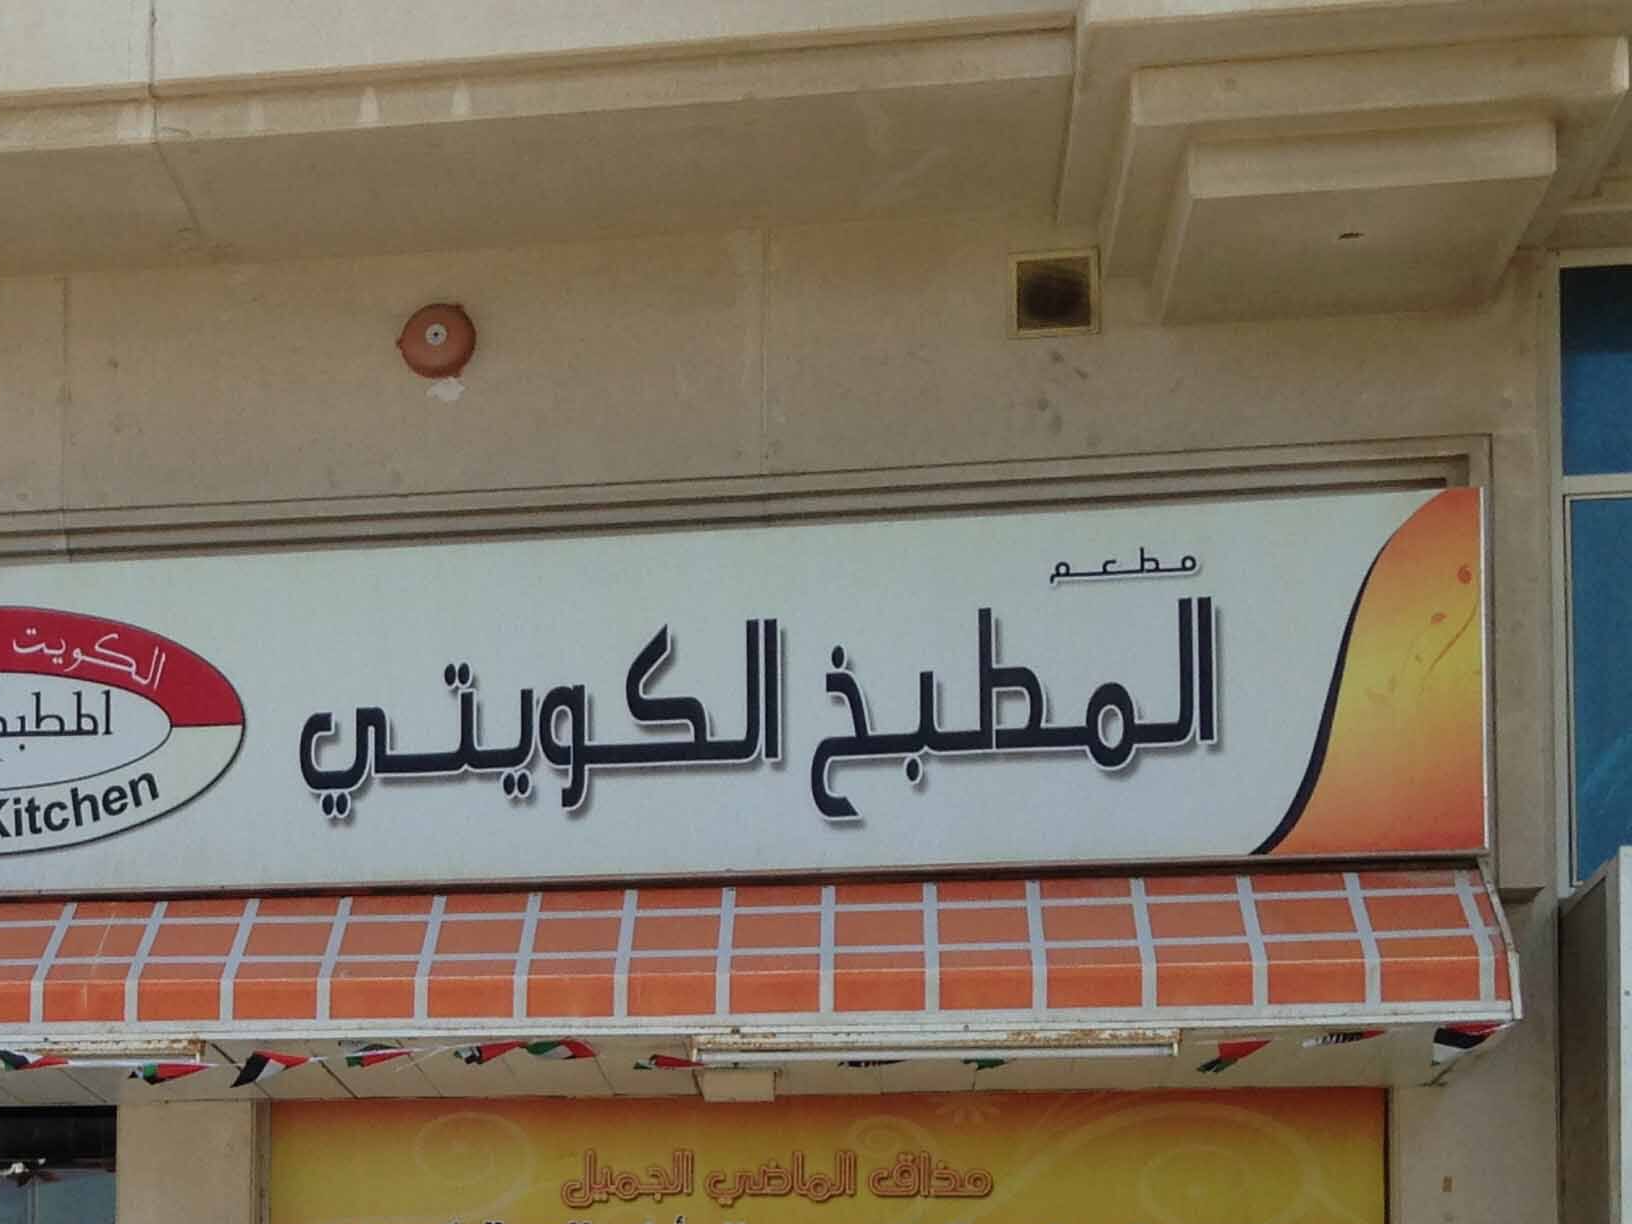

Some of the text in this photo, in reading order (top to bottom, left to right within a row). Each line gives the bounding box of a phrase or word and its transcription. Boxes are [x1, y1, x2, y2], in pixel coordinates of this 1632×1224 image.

[1050, 546, 1199, 584] مطعم
[11, 626, 166, 691] الكويت
[299, 595, 1218, 820] المطبخ الكويتي
[560, 1148, 996, 1208] مذاق الماضي الجميل
